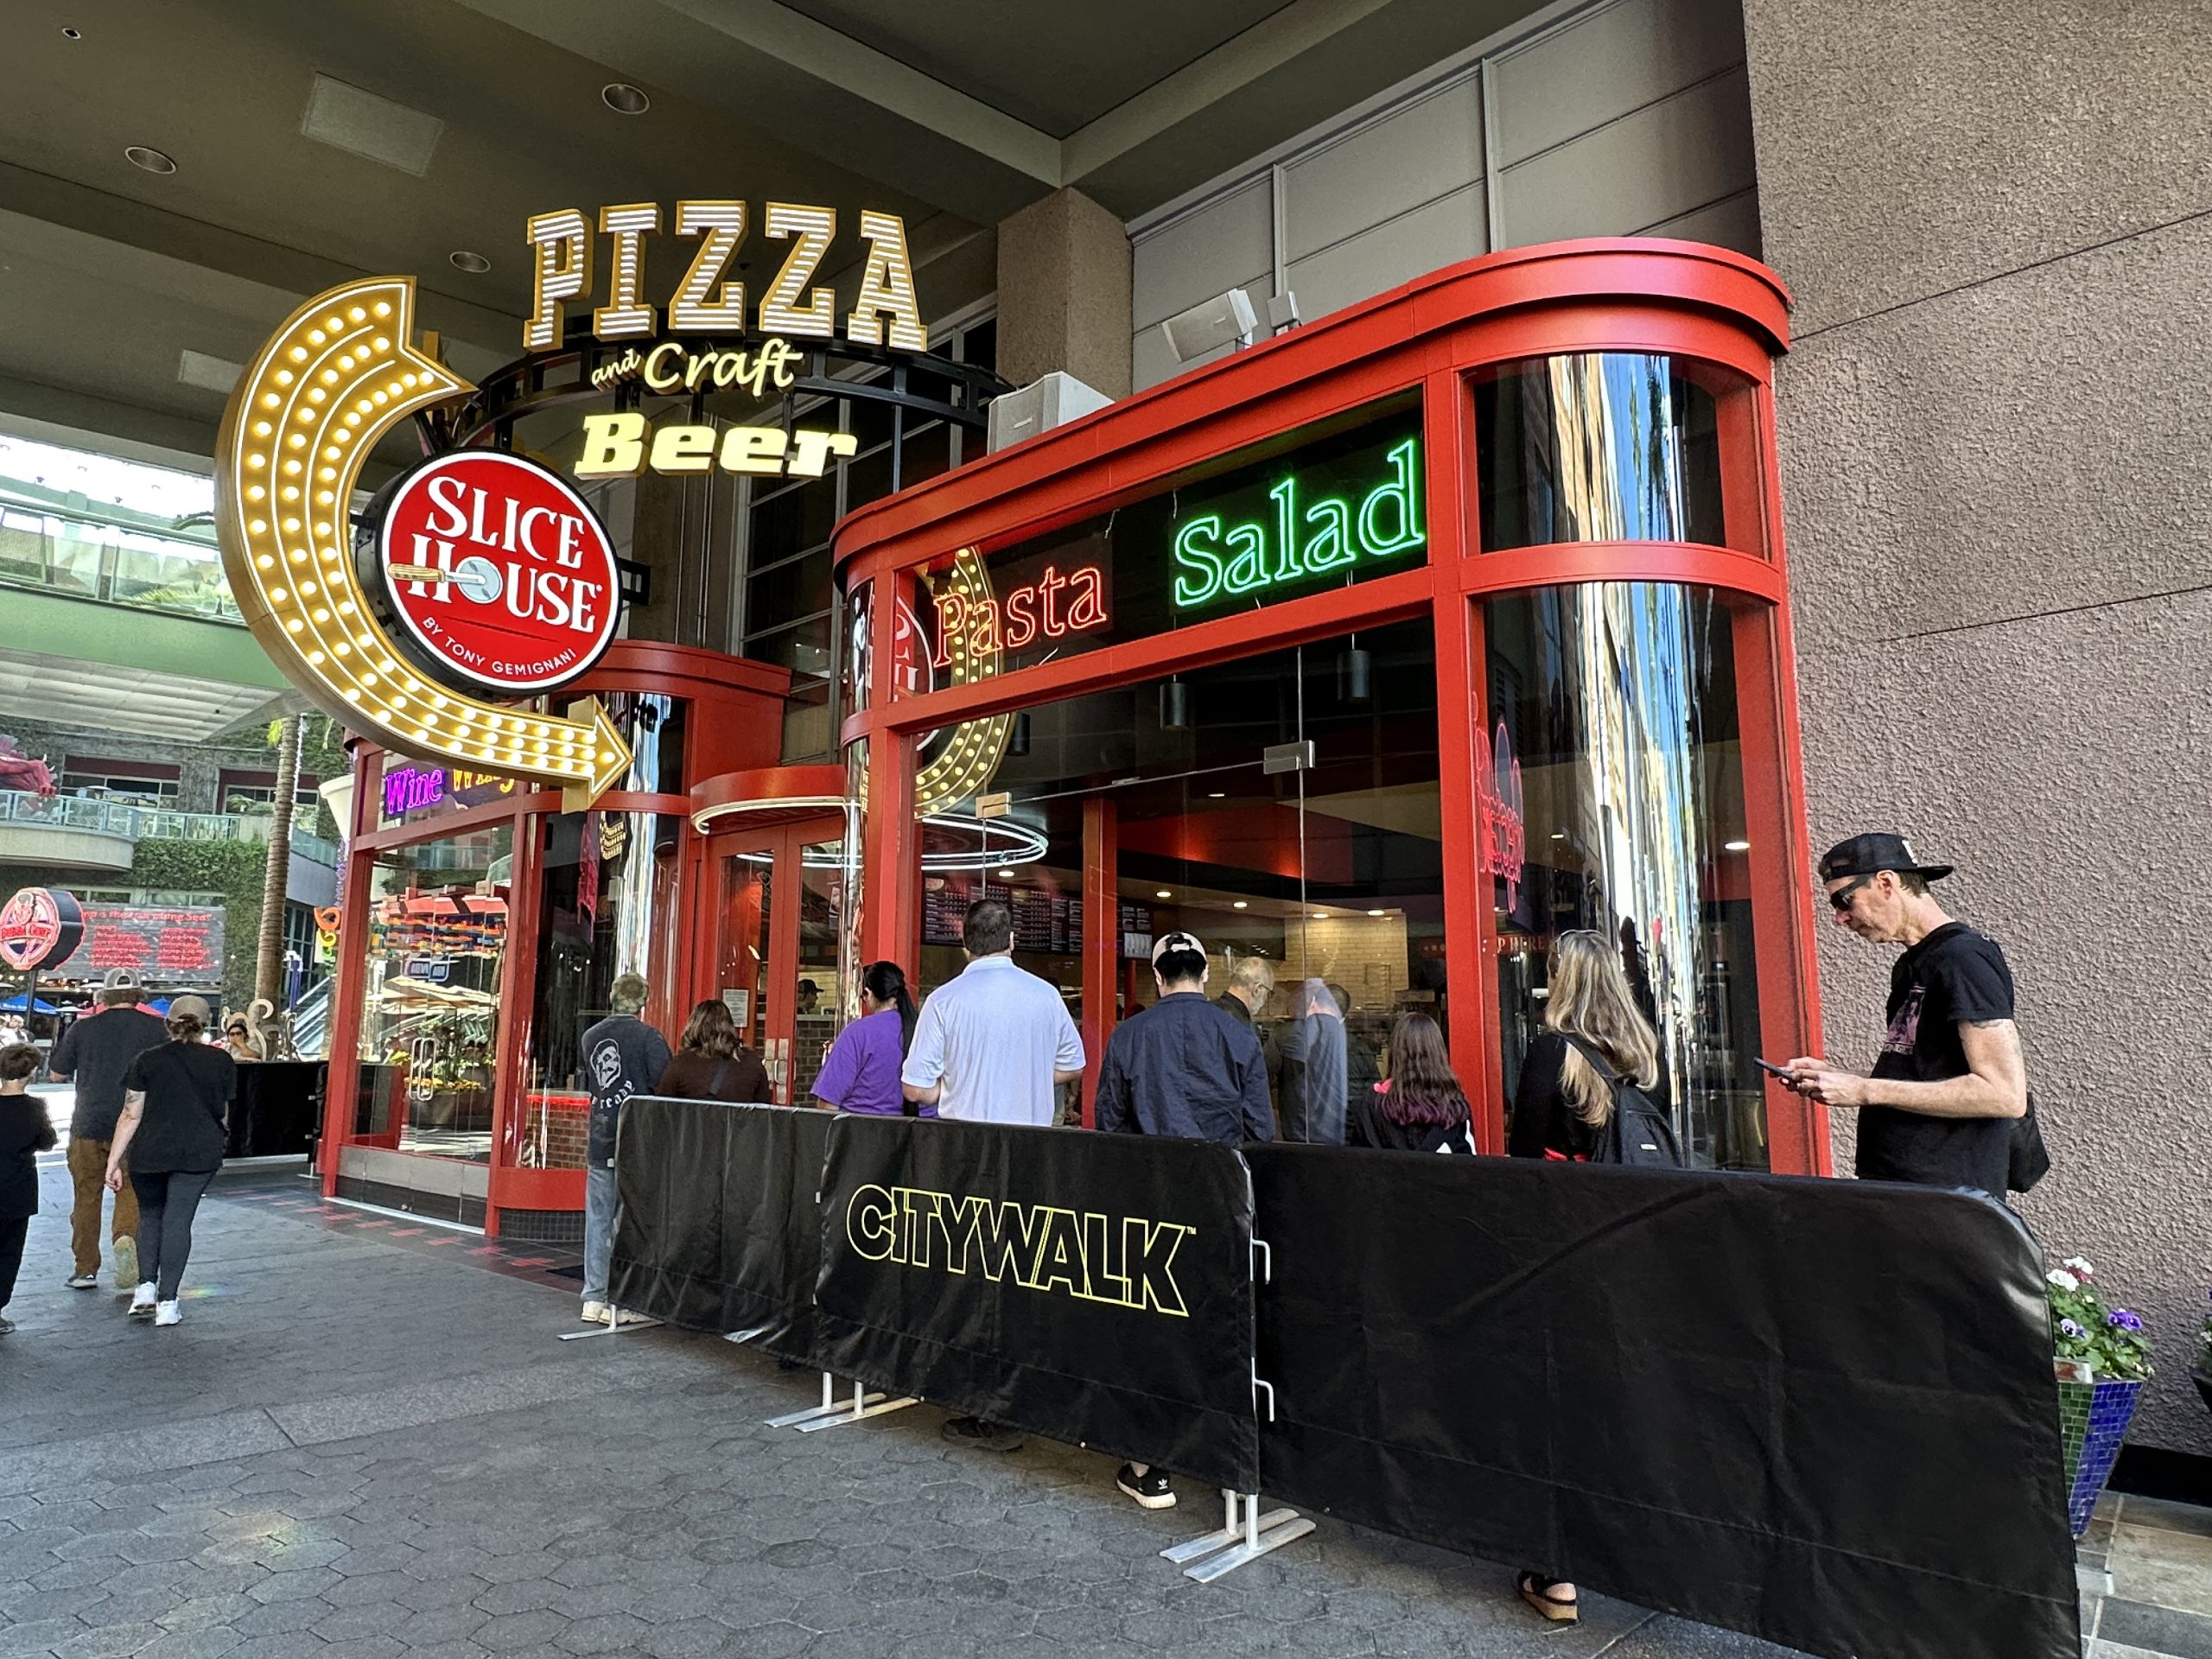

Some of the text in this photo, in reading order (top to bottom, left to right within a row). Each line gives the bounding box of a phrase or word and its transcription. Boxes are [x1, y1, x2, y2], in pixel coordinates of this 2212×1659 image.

[523, 200, 928, 352] PIZZA
[591, 338, 804, 397] and Craft
[573, 412, 858, 478] Beer
[425, 476, 585, 569] SLICE
[1173, 439, 1425, 607] Salad
[408, 533, 597, 633] HOUSE
[933, 564, 1107, 668] Pasta
[422, 615, 577, 676] BY TONY GEMIGNANI
[385, 768, 442, 815] Wine
